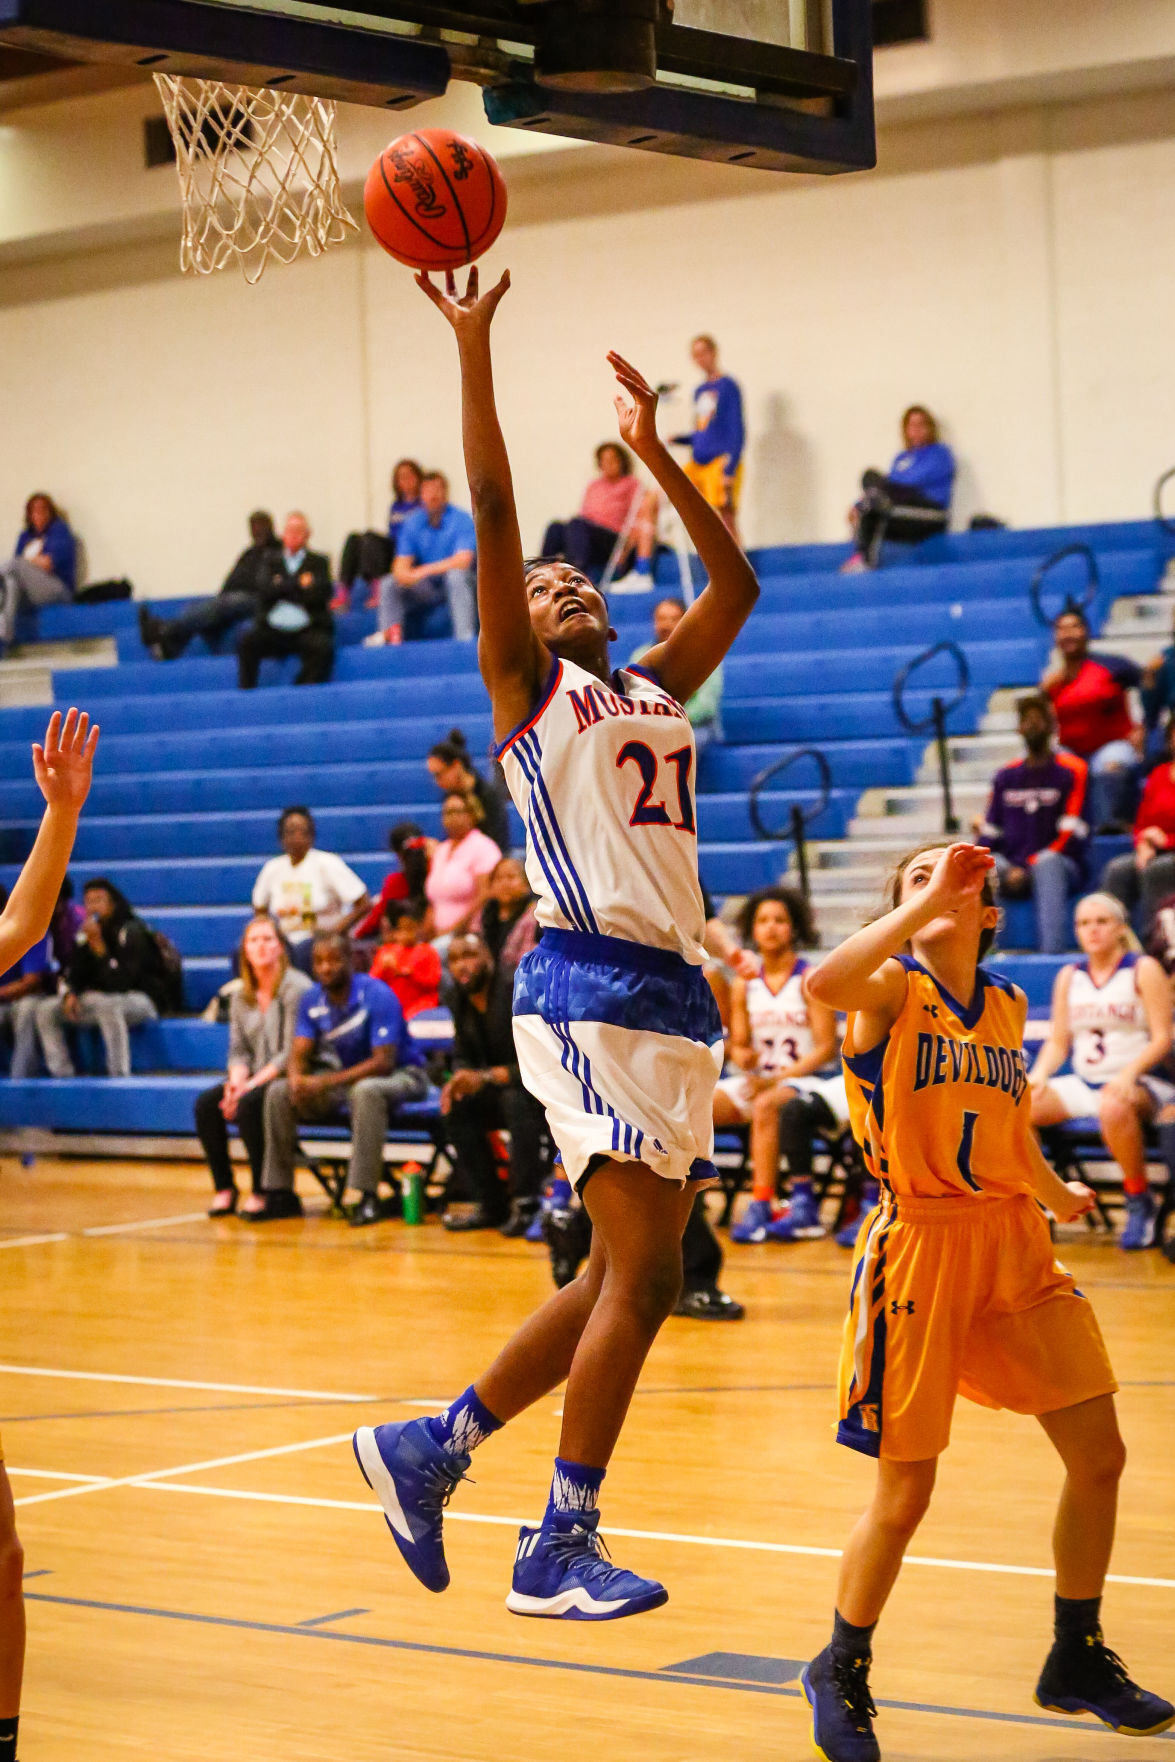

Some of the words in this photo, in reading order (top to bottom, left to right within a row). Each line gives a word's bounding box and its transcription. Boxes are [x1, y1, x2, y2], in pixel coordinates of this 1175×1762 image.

[389, 149, 447, 219] Rawlings
[616, 739, 696, 835] 21
[914, 1032, 1028, 1107] DEVILDOG
[1086, 1028, 1106, 1064] 3
[957, 1109, 983, 1192] 1
